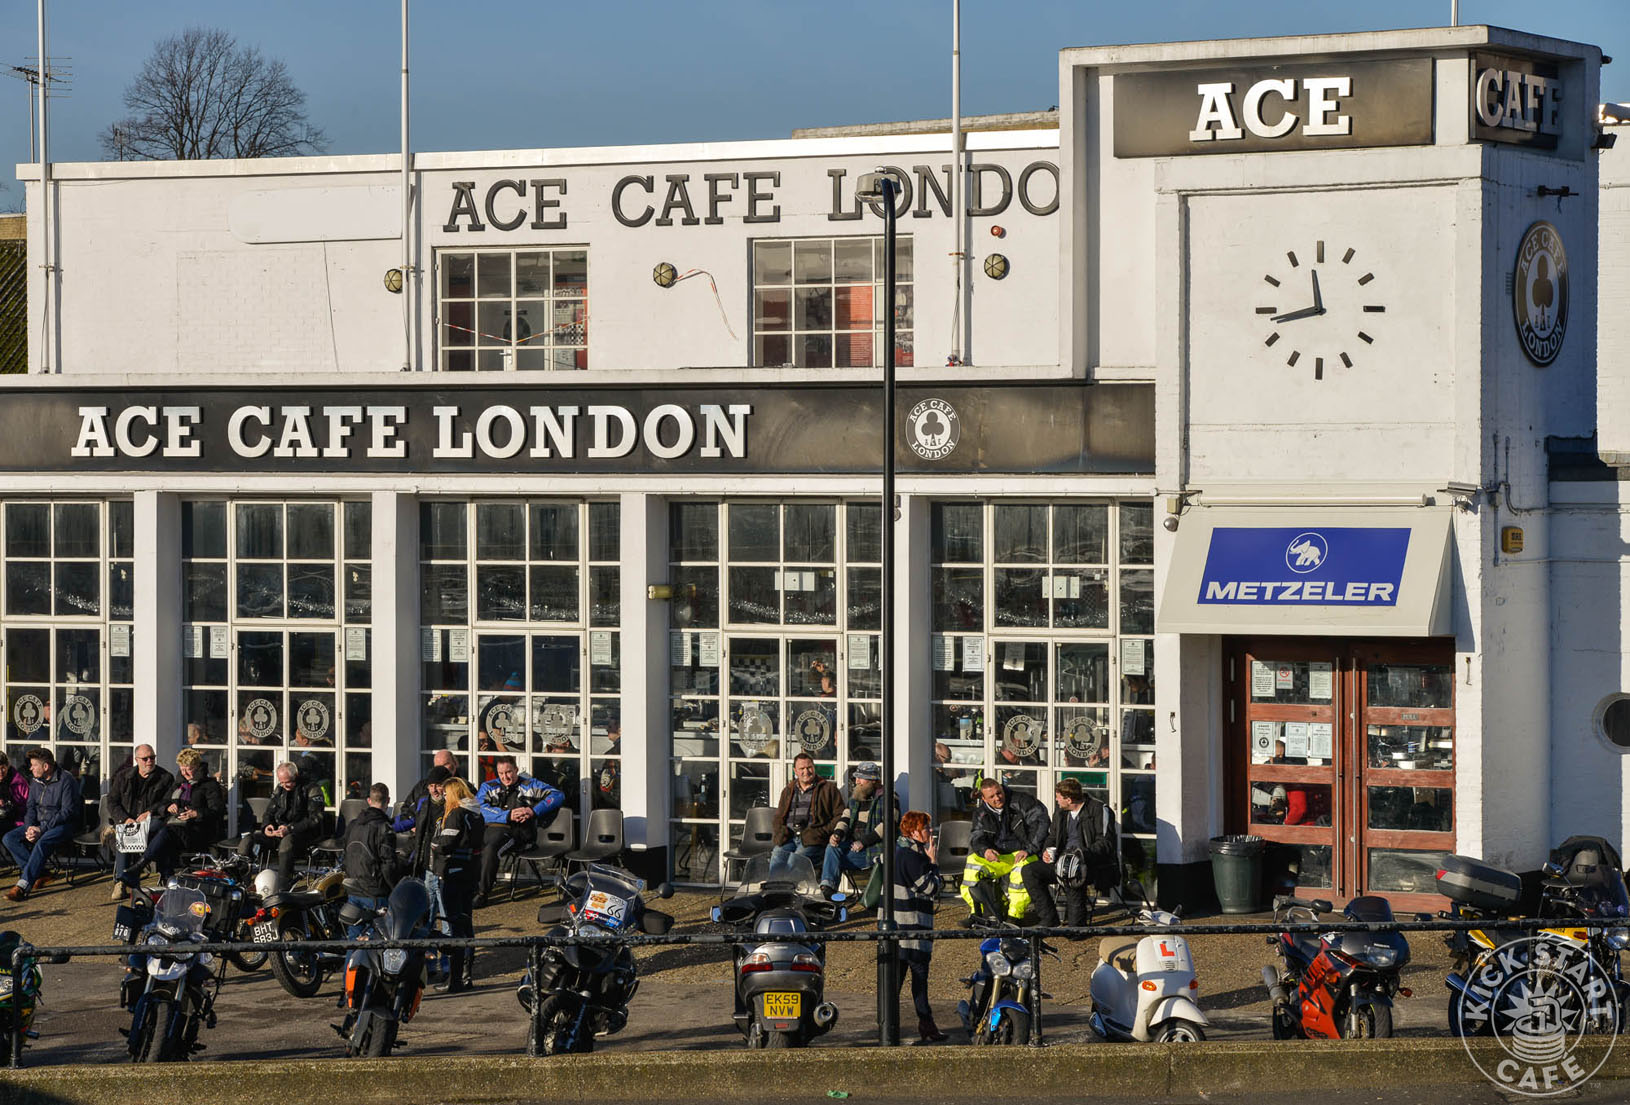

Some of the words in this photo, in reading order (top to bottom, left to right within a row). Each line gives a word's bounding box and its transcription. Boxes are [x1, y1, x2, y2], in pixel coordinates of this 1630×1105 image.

[1189, 77, 1350, 141] ACE
[1476, 67, 1562, 136] CAFE
[443, 178, 567, 232] ACE
[611, 171, 780, 228] CAFE
[1521, 234, 1538, 275] ACE
[1541, 231, 1565, 278] CAFE
[1521, 318, 1564, 358] LONDON
[910, 402, 928, 423] ACE
[930, 400, 956, 421] CAFE
[71, 405, 201, 457] ACE
[227, 405, 407, 458] CAFE
[433, 404, 751, 459] LONDON
[912, 439, 955, 458] LONDON
[1205, 581, 1395, 602] METZELER
[247, 700, 259, 713] ACE
[259, 699, 275, 713] CAFE
[299, 702, 311, 714] ACE
[311, 701, 327, 714] CAFE
[607, 905, 623, 918] 66
[254, 921, 272, 936] BHT
[1159, 943, 1175, 957] L
[766, 994, 799, 1005] EK59
[770, 1005, 794, 1016] NVW
